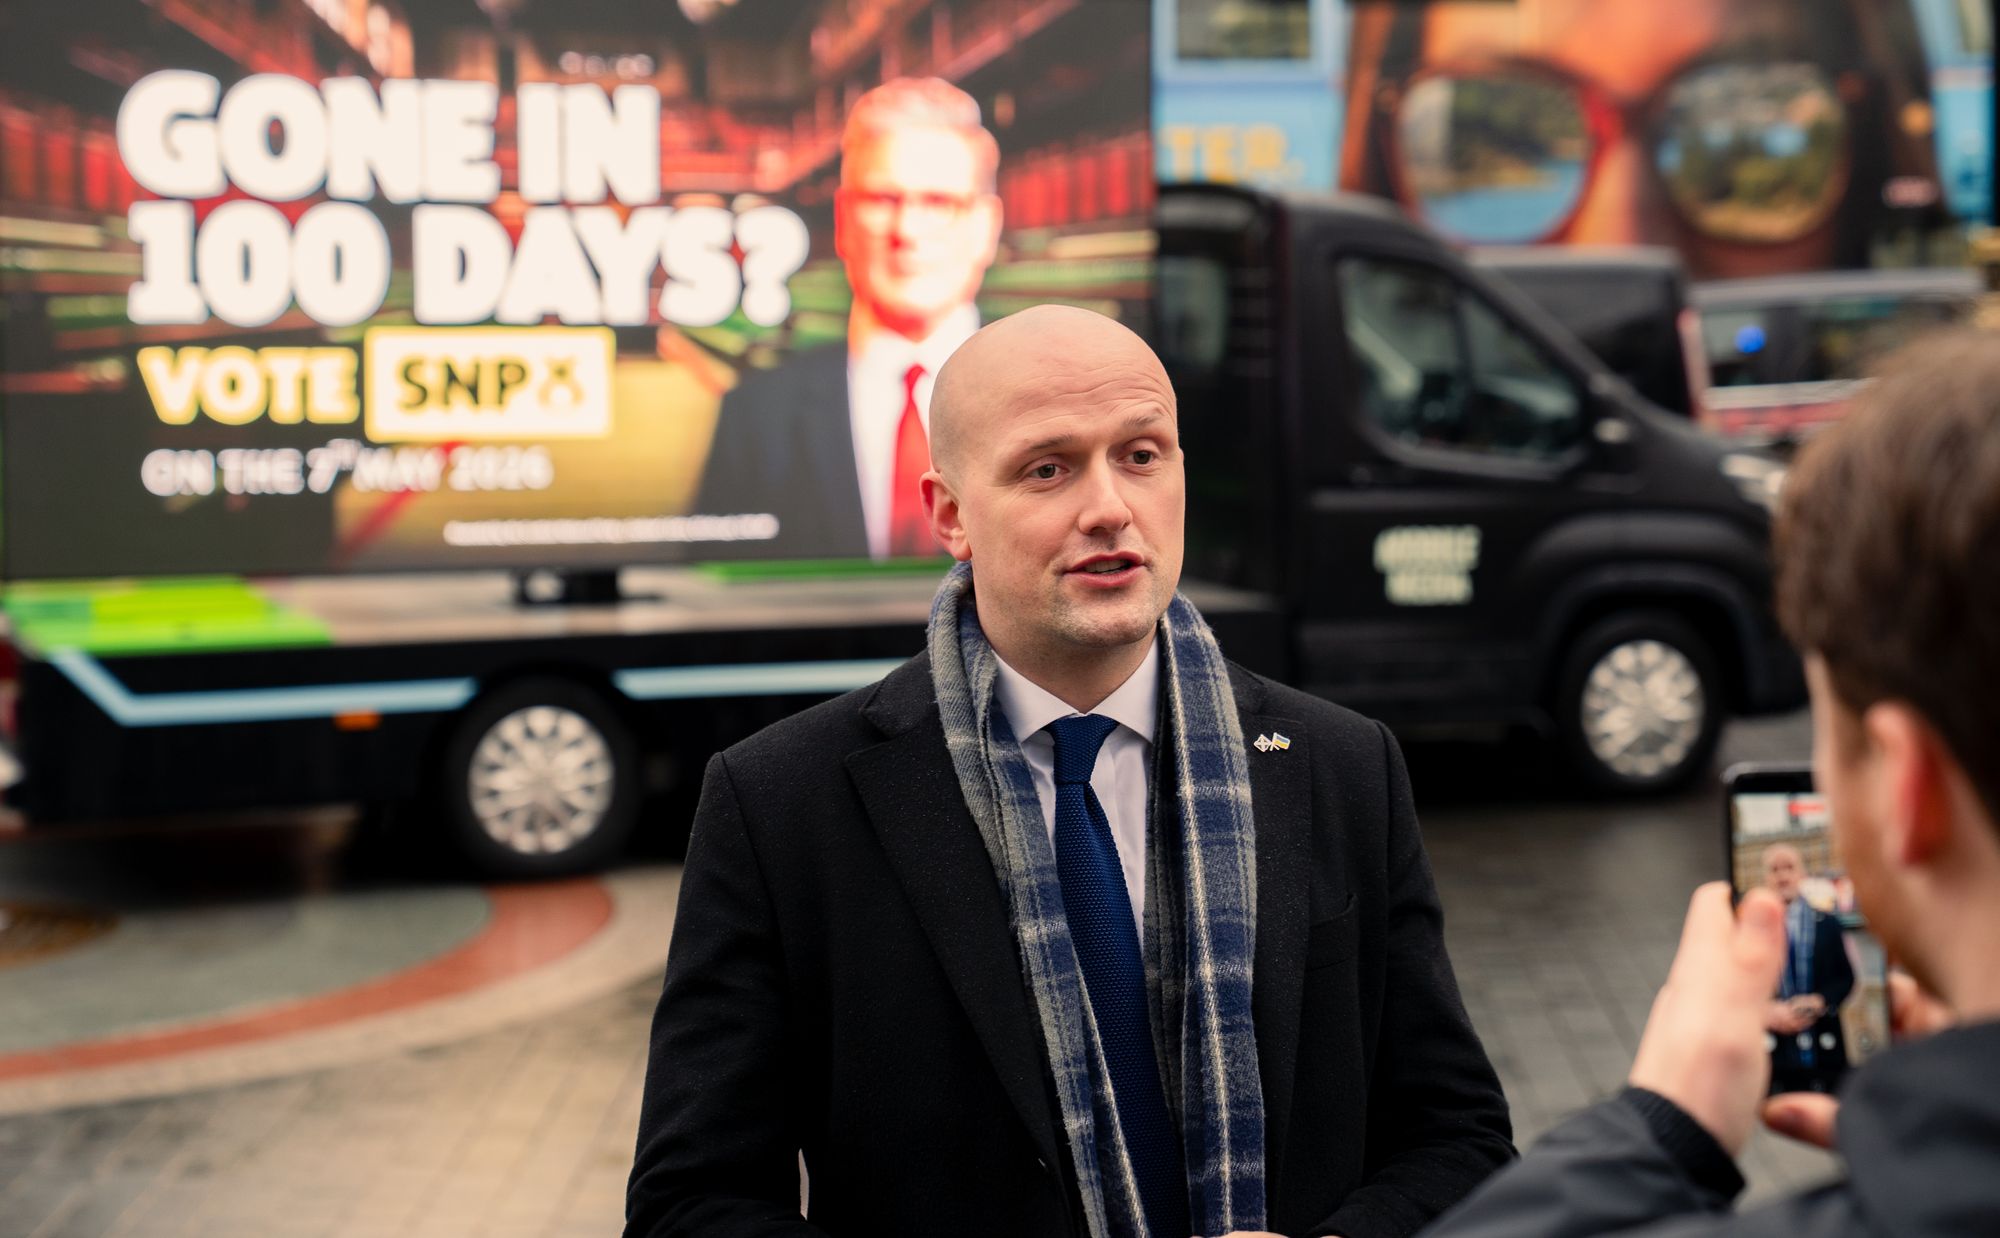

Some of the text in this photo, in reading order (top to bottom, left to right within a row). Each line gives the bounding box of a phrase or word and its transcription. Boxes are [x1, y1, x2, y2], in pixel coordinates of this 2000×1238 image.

[117, 69, 661, 204] GONE IN
[127, 201, 810, 329] 100 DAYS?
[137, 345, 528, 425] VOTE SNP
[141, 448, 216, 496] ON
[218, 448, 305, 495] THE
[353, 446, 446, 493] MAY
[450, 445, 554, 491] 2026
